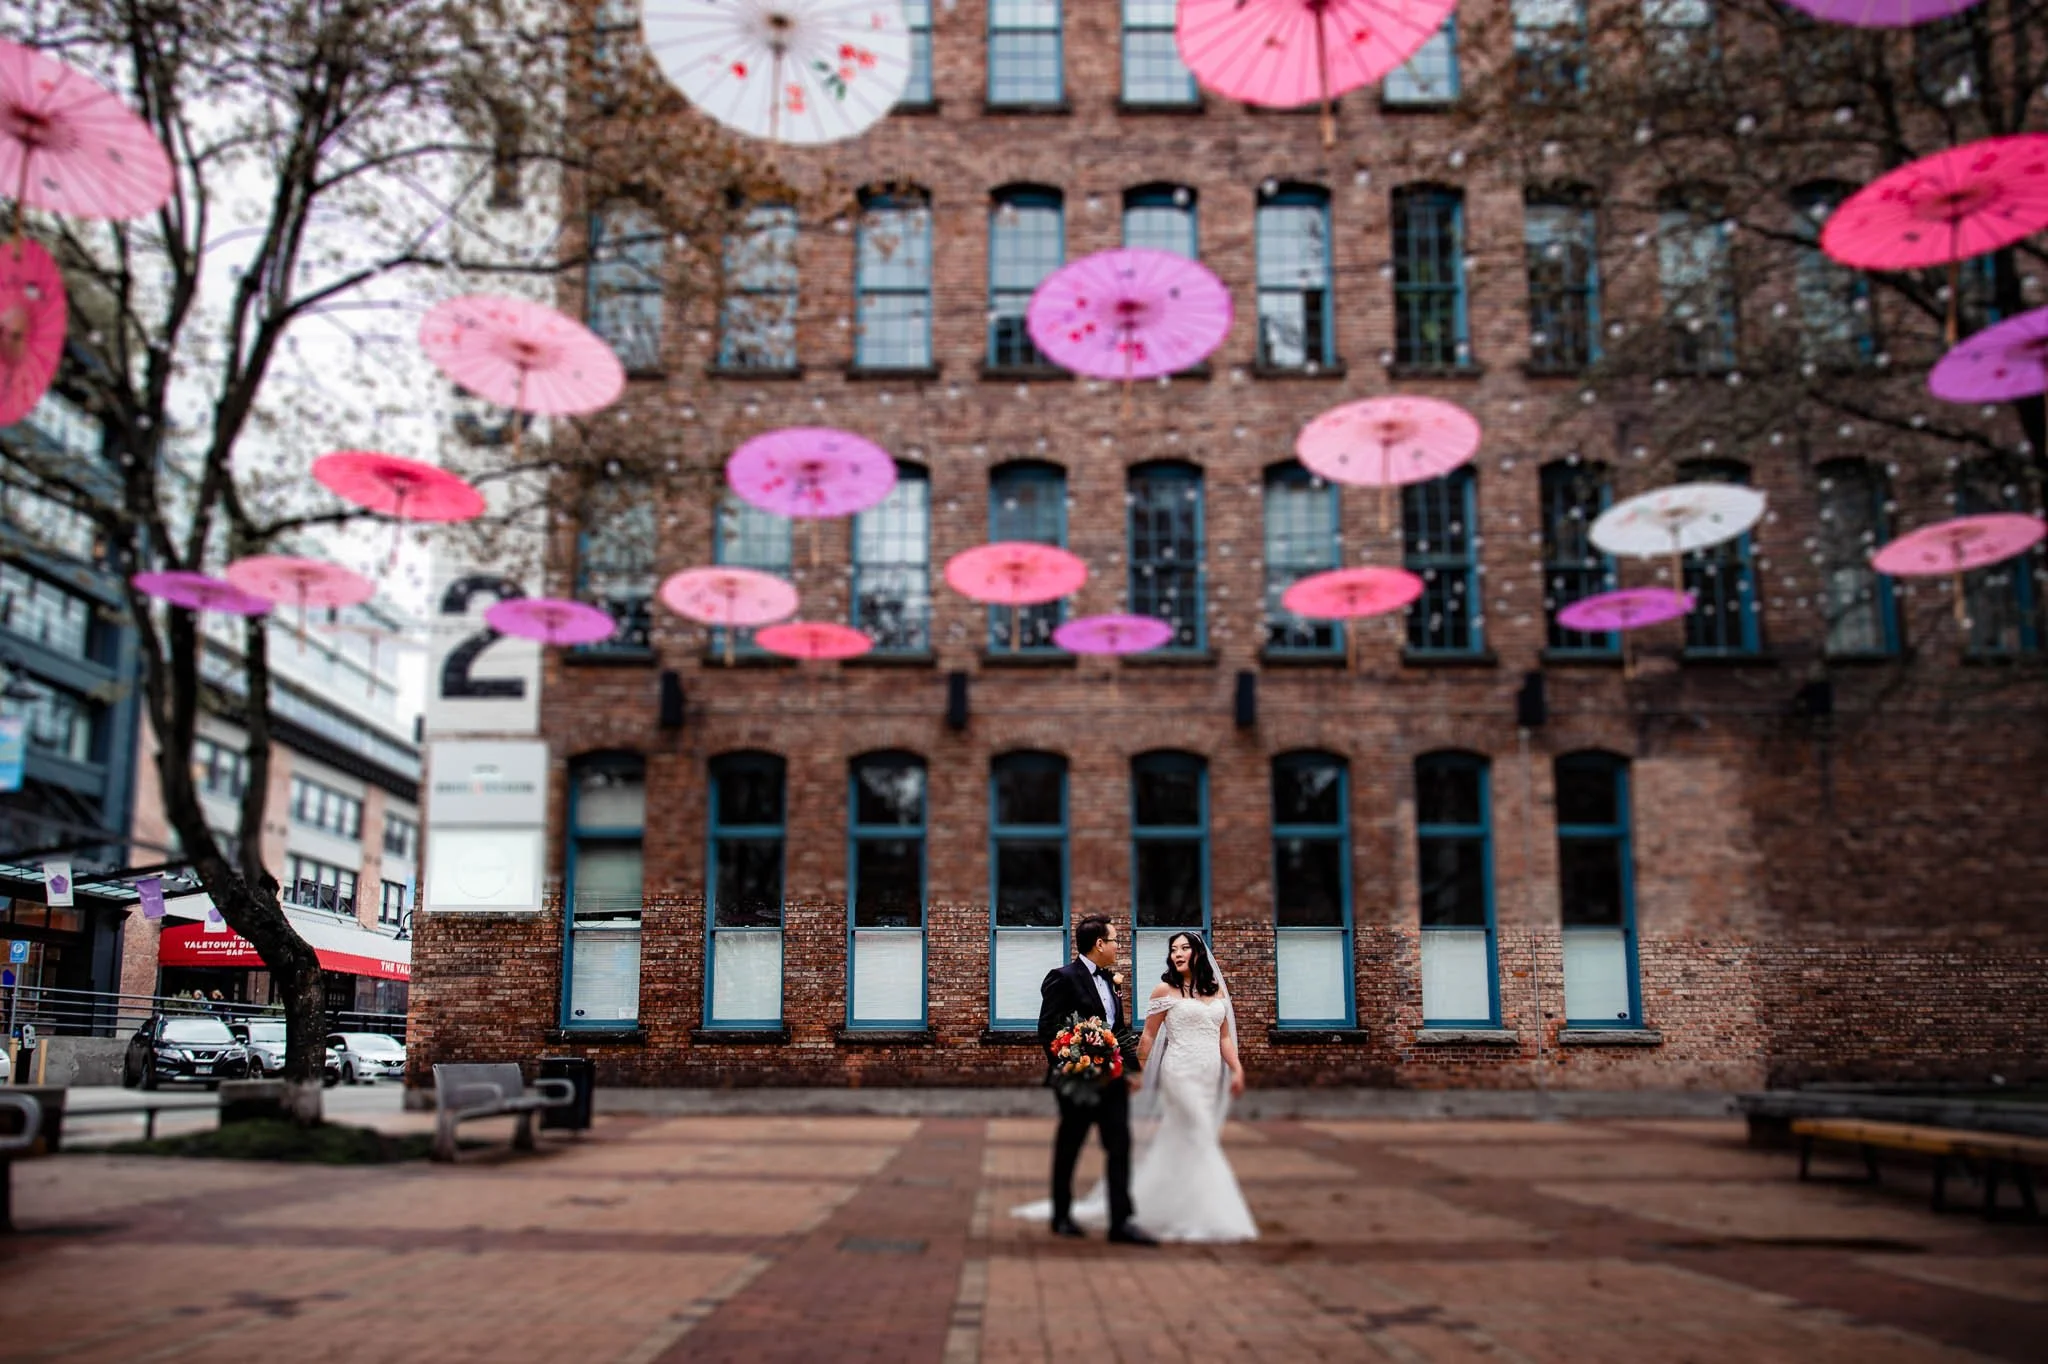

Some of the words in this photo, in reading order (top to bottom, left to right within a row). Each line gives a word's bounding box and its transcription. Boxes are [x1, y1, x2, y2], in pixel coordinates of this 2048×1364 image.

[441, 575, 526, 699] 2
[184, 941, 237, 949] YALETOWN
[381, 961, 395, 973] THE
